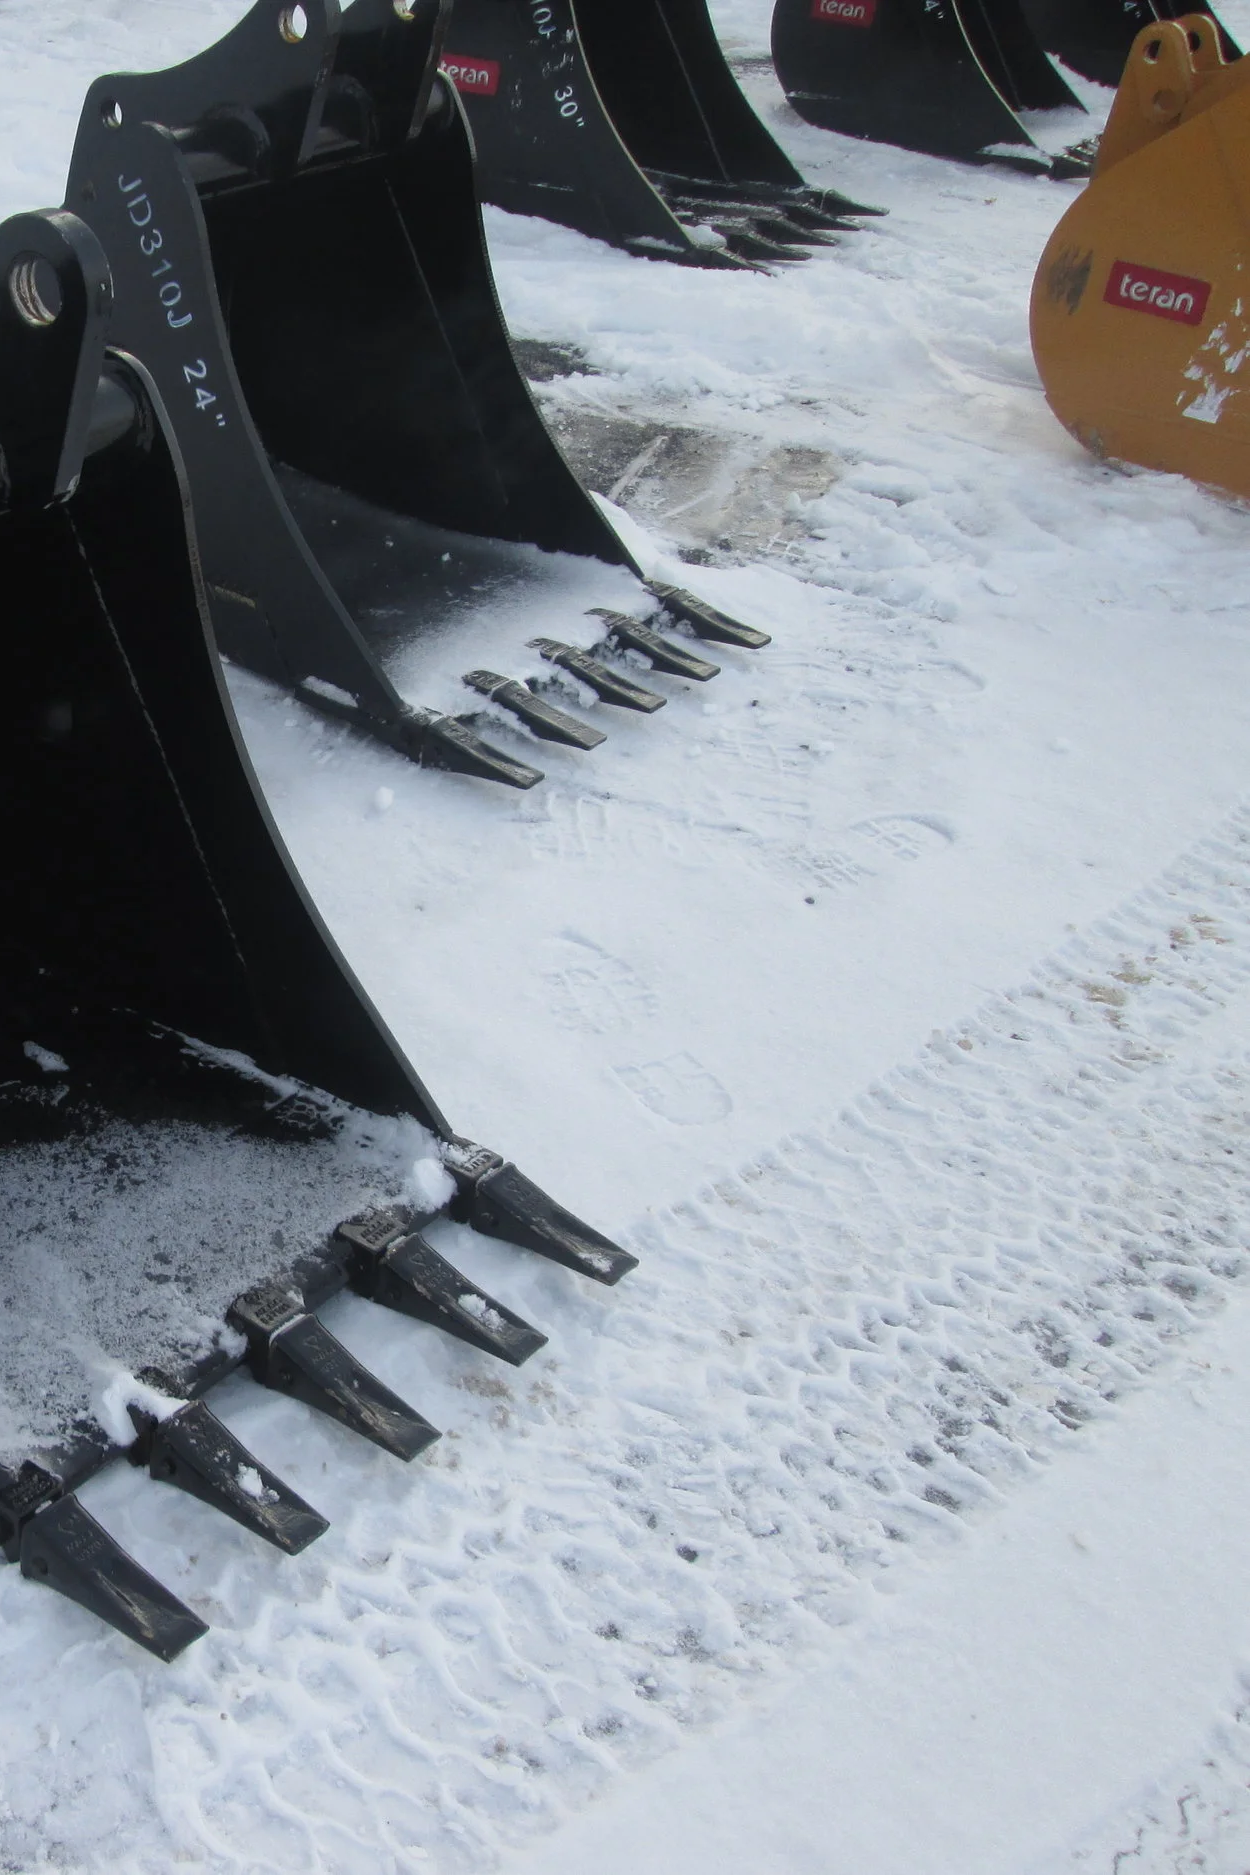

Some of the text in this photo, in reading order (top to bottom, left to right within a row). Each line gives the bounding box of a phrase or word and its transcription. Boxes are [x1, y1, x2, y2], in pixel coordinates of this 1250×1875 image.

[554, 86, 585, 127] 30"
[118, 174, 226, 427] JD310J 24"
[1119, 272, 1195, 316] teran
